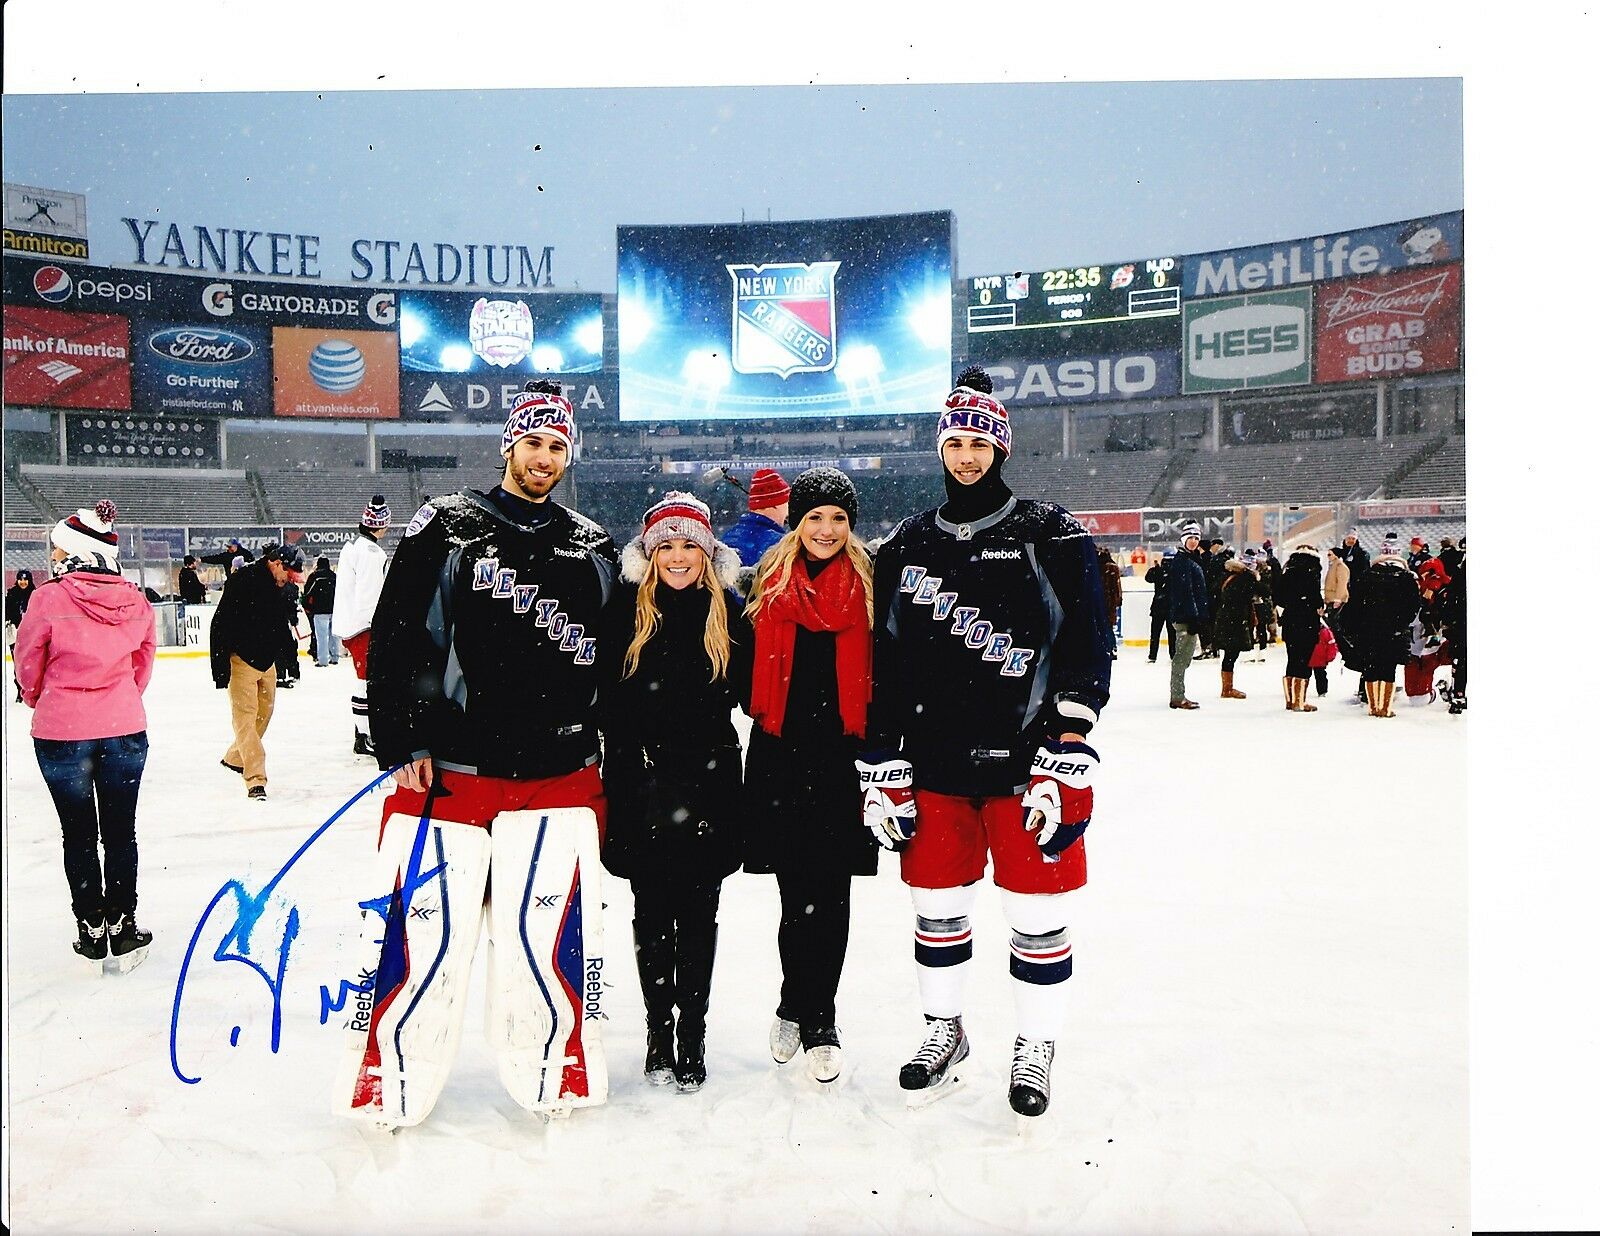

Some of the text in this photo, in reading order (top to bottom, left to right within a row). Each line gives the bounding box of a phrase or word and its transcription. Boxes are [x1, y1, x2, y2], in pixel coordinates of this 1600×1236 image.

[4, 230, 87, 257] Armitron
[121, 217, 555, 288] YANKEE STADIUM
[1146, 258, 1174, 273] NJD
[1195, 237, 1380, 295] MetLife
[78, 279, 151, 303] pepsi
[740, 275, 827, 296] NEW YORK
[974, 277, 1002, 290] NYR
[1042, 267, 1101, 291] 22:35
[1154, 271, 1165, 287] 0
[242, 293, 359, 316] GATORADE
[980, 289, 991, 305] 0
[752, 301, 826, 361] RANGERS
[1195, 324, 1299, 360] HESS
[1347, 320, 1425, 344] GRAB
[35, 337, 54, 353] of
[56, 338, 126, 358] America
[170, 332, 234, 360] Ford
[1347, 350, 1424, 375] BUDS
[167, 374, 239, 389] Go Further
[983, 356, 1156, 400] CASIO
[162, 398, 226, 409] tristateford.com
[467, 384, 605, 409] DETA
[743, 460, 808, 470] MERCHANDISE
[810, 459, 840, 468] STORE
[554, 547, 587, 560] Reebok
[981, 549, 1022, 560] Reebok
[472, 557, 597, 665] NEW YORK
[900, 565, 1035, 677] NEW YORK
[351, 967, 376, 1032] Reebok
[585, 957, 603, 1020] Reebok
